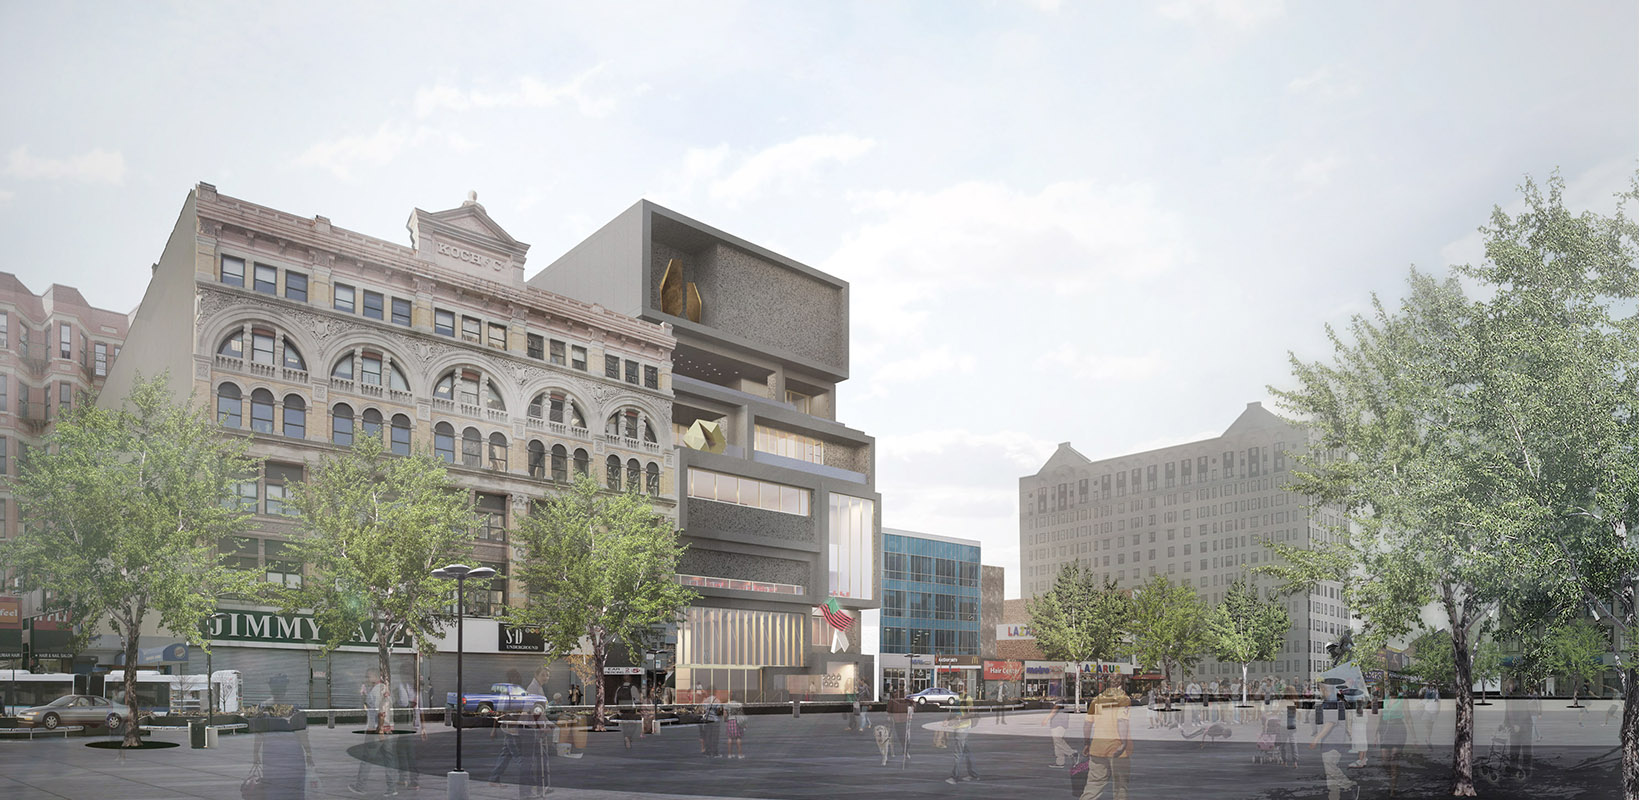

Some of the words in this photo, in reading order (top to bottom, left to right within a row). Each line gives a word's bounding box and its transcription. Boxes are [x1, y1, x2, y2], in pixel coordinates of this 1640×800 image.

[437, 242, 482, 267] KOCH
[210, 611, 323, 641] JIMMY
[1079, 664, 1121, 673] LAZARUS
